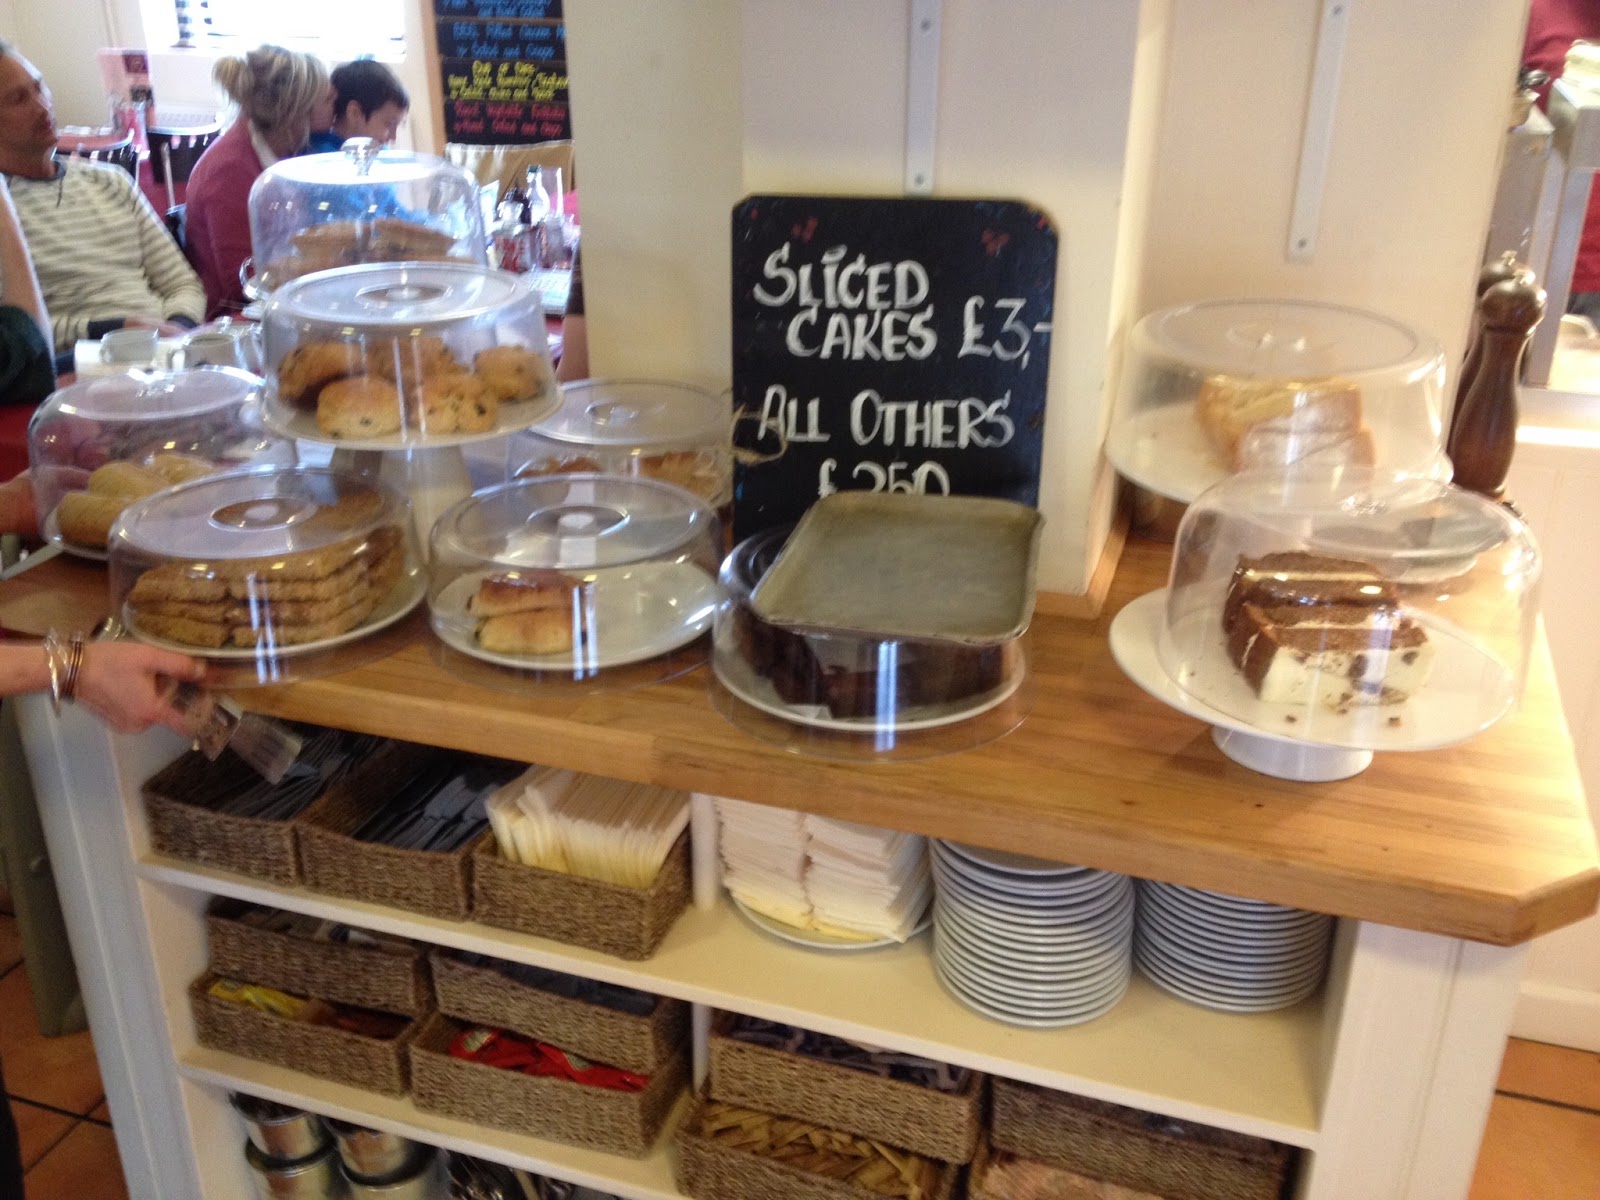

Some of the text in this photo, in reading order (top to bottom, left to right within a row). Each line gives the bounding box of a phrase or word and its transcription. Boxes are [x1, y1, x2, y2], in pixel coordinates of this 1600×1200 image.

[753, 241, 930, 309] SLICED
[785, 303, 938, 361] CAKES
[757, 383, 1016, 449] ALL OTHERS
